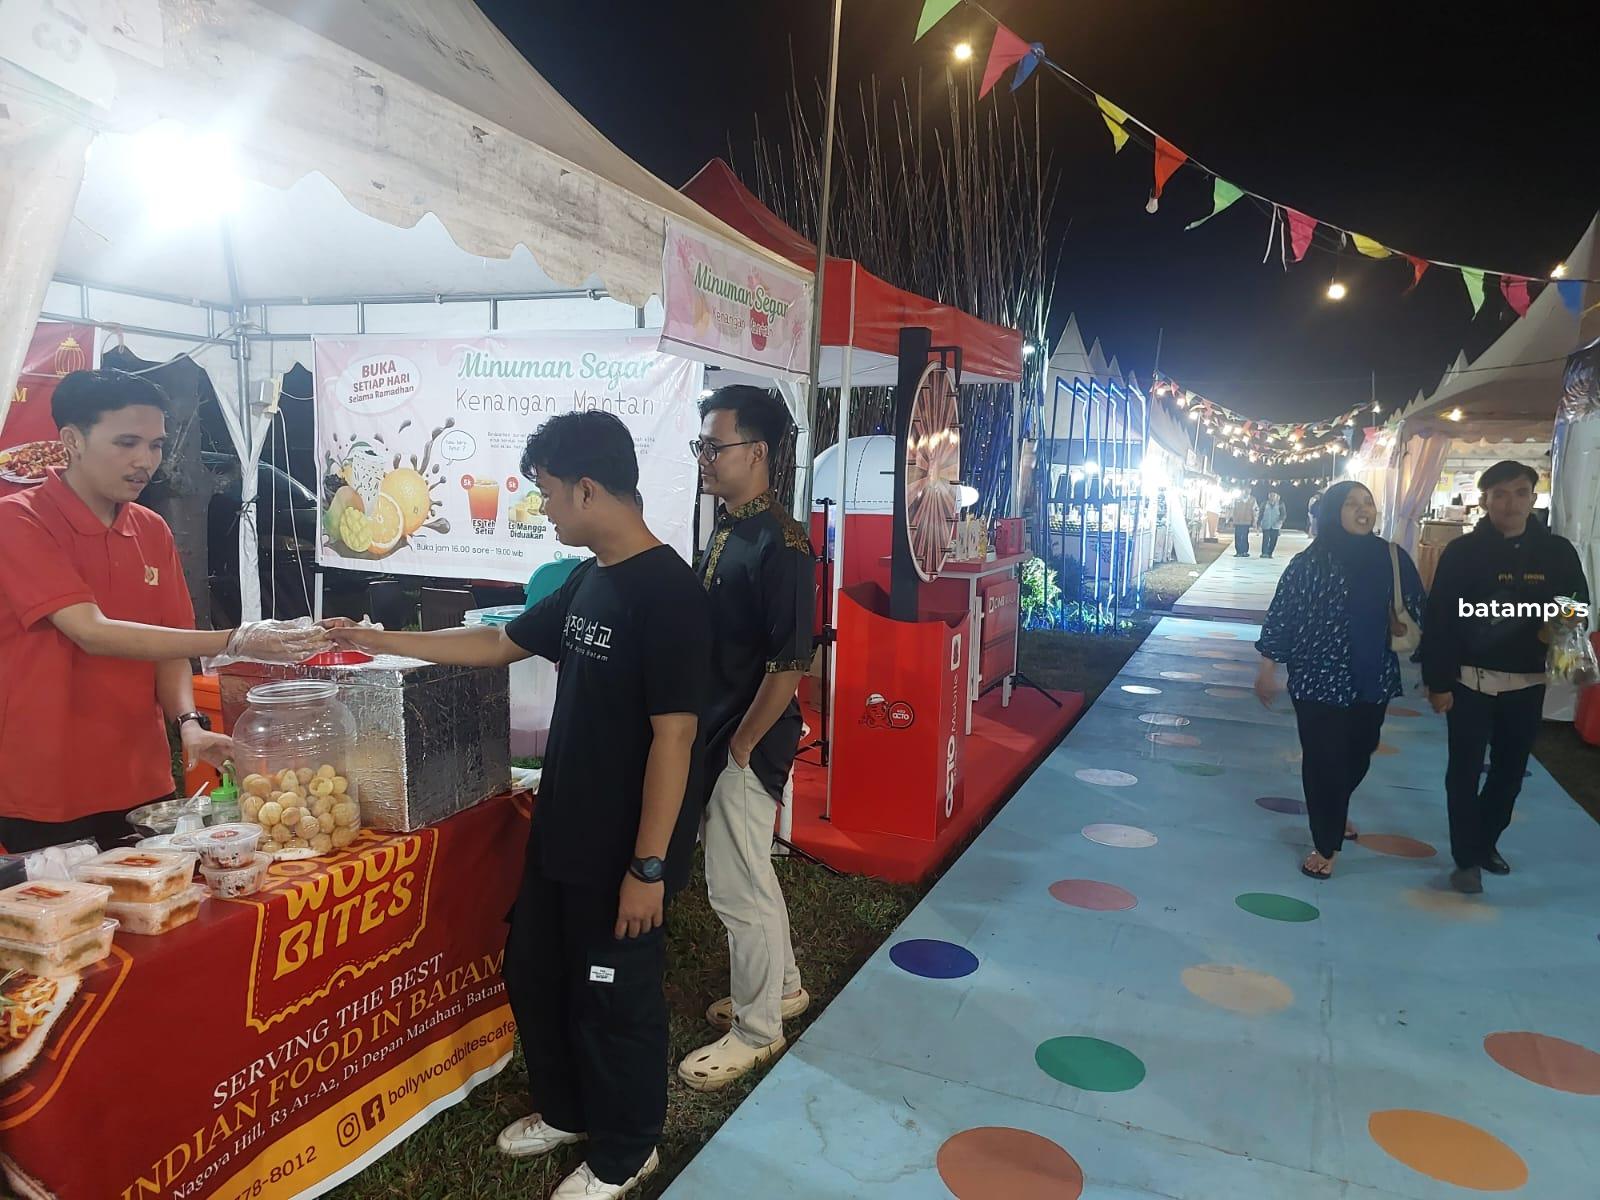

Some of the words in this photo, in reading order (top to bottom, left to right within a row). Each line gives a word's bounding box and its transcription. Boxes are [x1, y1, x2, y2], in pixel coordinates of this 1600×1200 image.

[694, 261, 752, 307] Minuman
[755, 286, 789, 323] Segar
[353, 377, 385, 393] SETIAP
[386, 372, 410, 387] HARI
[361, 359, 397, 379] BUKA
[458, 352, 574, 378] Minuman
[579, 352, 654, 390] Segar
[348, 392, 374, 404] Selama
[374, 385, 415, 399] Ramadhan
[456, 387, 556, 416] Kenangan
[573, 387, 654, 415] Mantan
[475, 527, 494, 535] Setia
[510, 530, 544, 540] Diduakan
[517, 522, 547, 533] Mangga
[416, 543, 434, 551] Buka
[435, 543, 450, 553] jam
[451, 545, 470, 553] 16.00
[511, 550, 524, 558] wib
[271, 835, 422, 920] WOOD
[273, 871, 415, 980] BITES
[213, 1018, 330, 1110] SERVING
[336, 985, 384, 1030] THE
[389, 952, 444, 1000] BEST
[266, 1027, 363, 1109] FOOD
[370, 1001, 403, 1042] IN
[409, 948, 505, 1019] BATAM
[388, 1020, 515, 1106] bollywoodbitescafe
[172, 1152, 230, 1200] Nagoya
[234, 1121, 266, 1156] Hill,
[269, 1108, 288, 1128] R3
[343, 1060, 359, 1081] Di
[361, 1035, 404, 1069] Depan
[406, 1000, 465, 1042] Matahari,
[466, 981, 506, 1008] Batam
